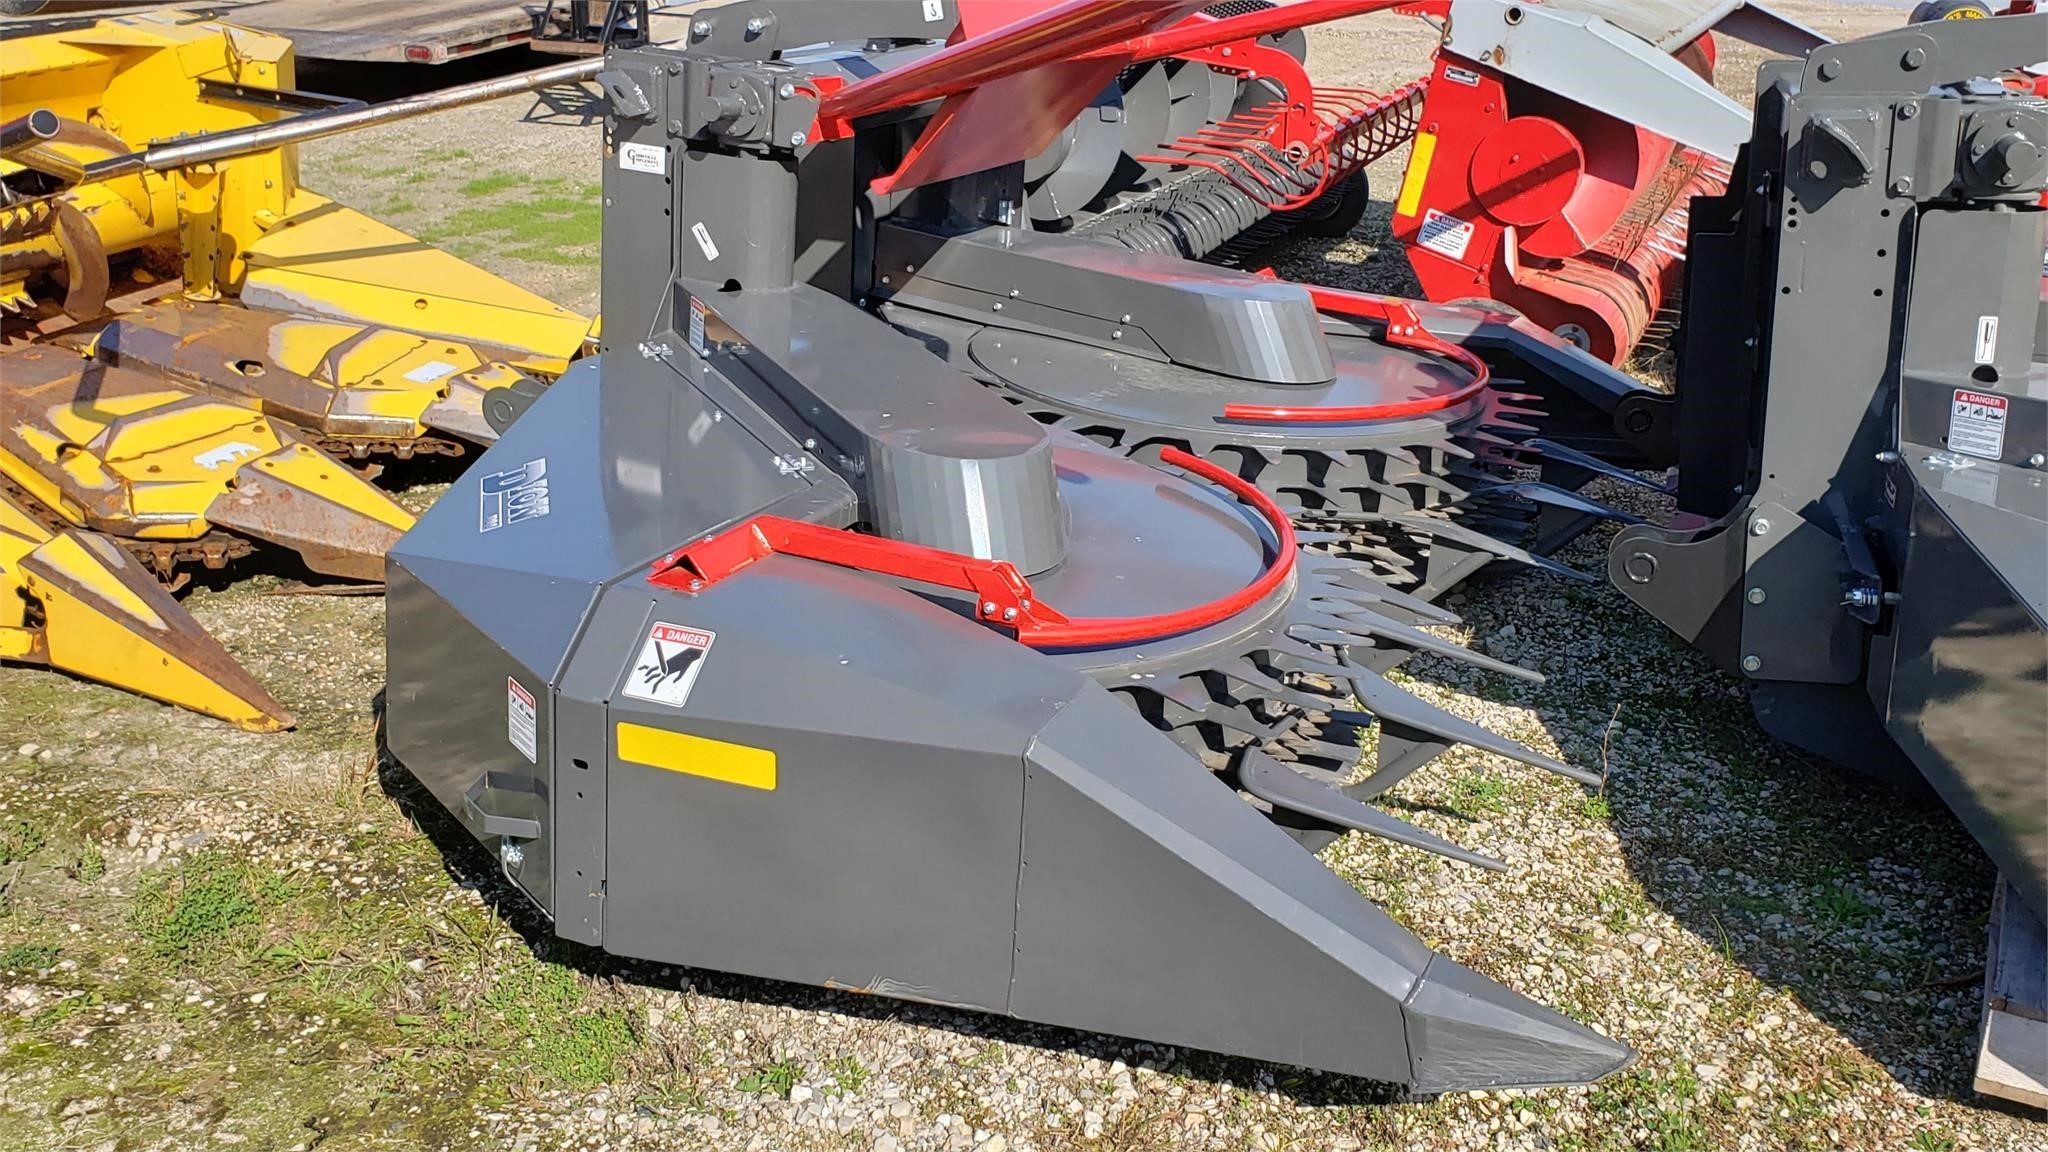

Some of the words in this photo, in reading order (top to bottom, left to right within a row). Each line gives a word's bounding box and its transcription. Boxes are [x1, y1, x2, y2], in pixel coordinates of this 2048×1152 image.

[1970, 395, 2000, 407] DANGER
[481, 457, 550, 525] DION
[666, 630, 708, 646] DANGER
